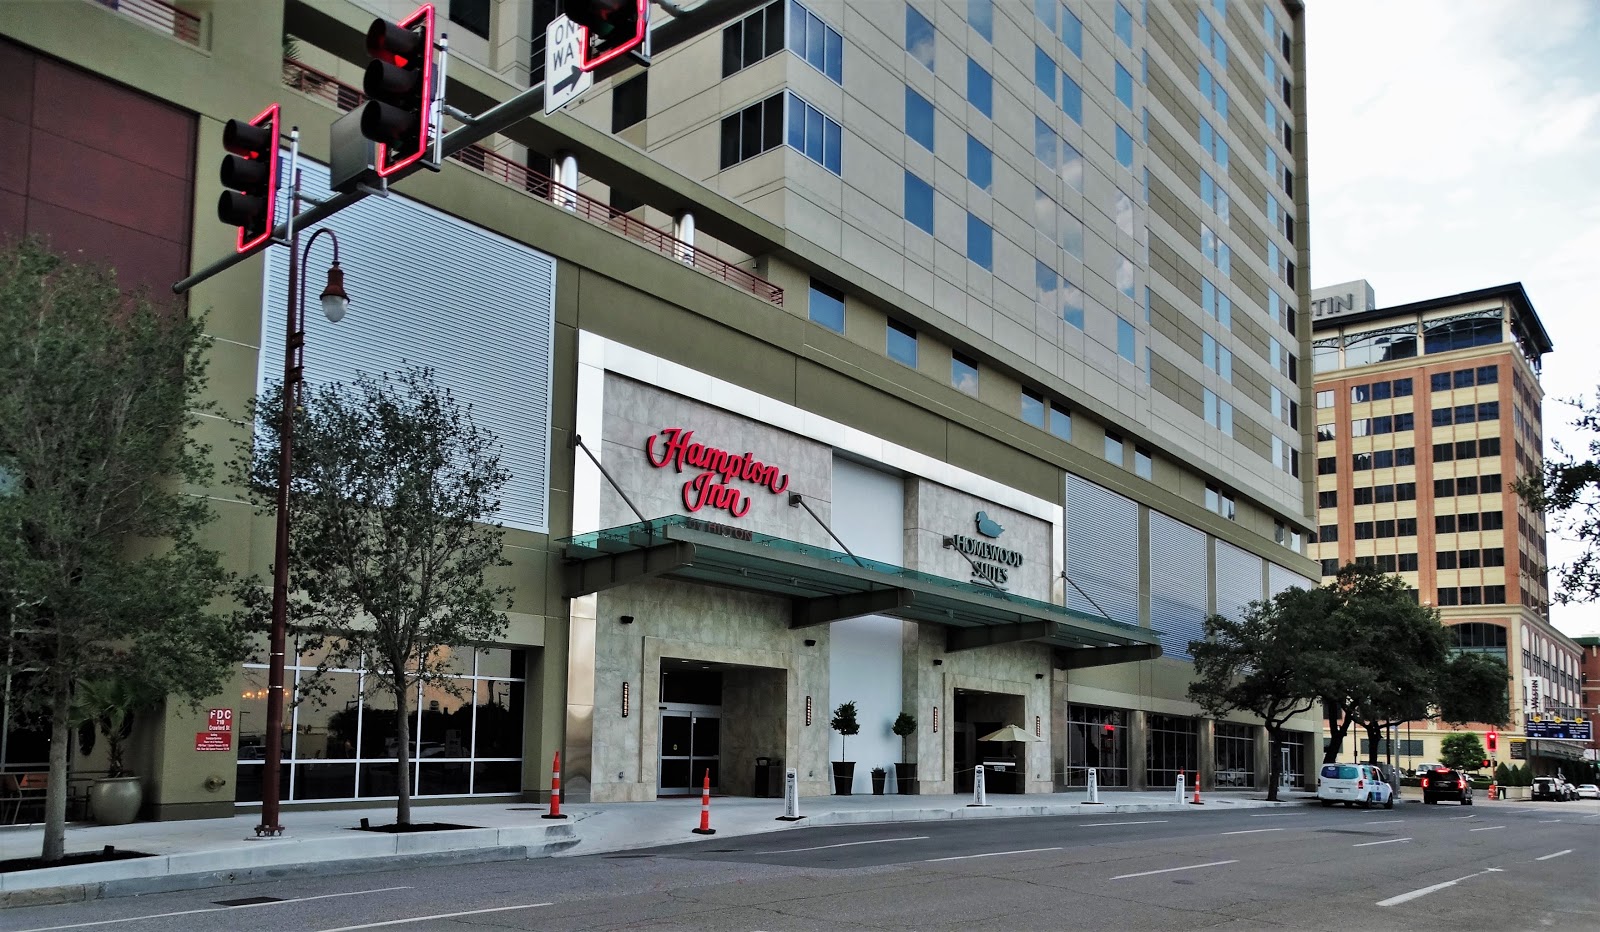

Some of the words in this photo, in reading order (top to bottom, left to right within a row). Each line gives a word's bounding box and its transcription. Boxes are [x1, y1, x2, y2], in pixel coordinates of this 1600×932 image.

[646, 428, 789, 494] Hampton
[682, 471, 751, 517] Inn
[954, 534, 1024, 567] HOMEWOOD
[971, 560, 1008, 583] SUITES
[210, 709, 231, 719] FDC
